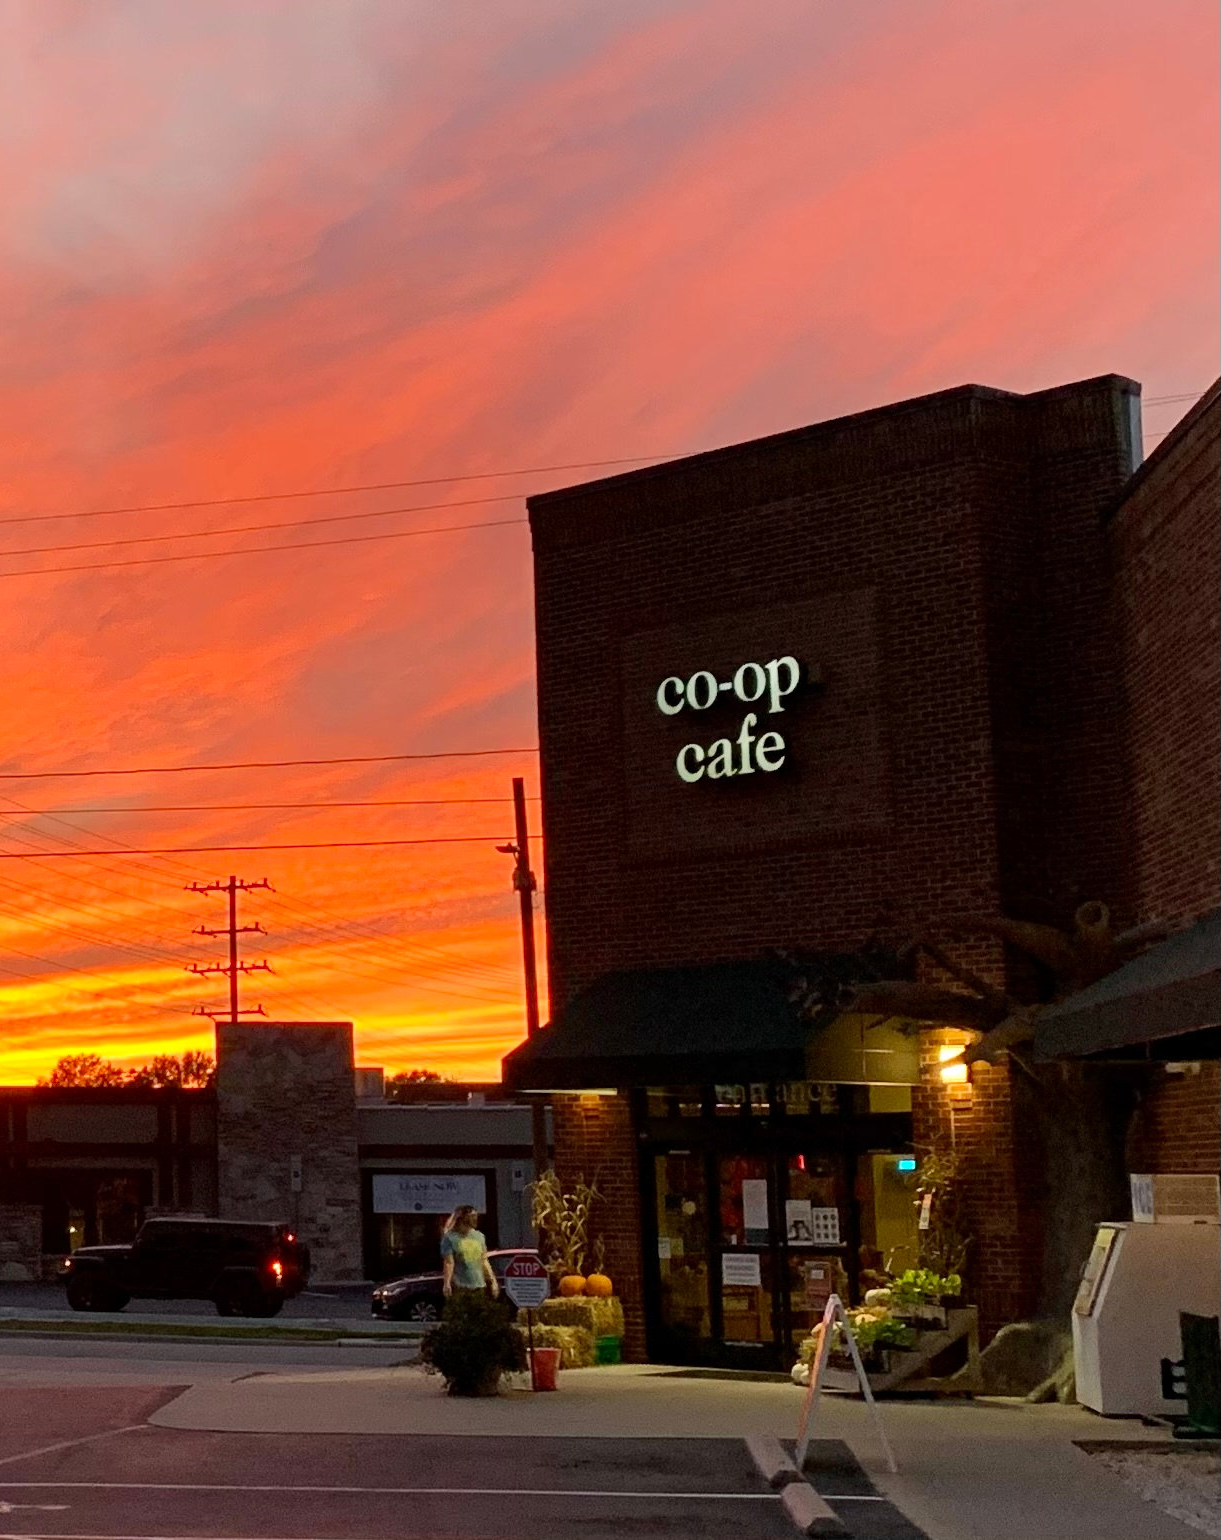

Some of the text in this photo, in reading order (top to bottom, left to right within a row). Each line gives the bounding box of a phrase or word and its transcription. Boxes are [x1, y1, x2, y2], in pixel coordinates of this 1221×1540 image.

[656, 655, 800, 715] co-op
[676, 713, 786, 783] cafe
[512, 1262, 541, 1276] STOP
